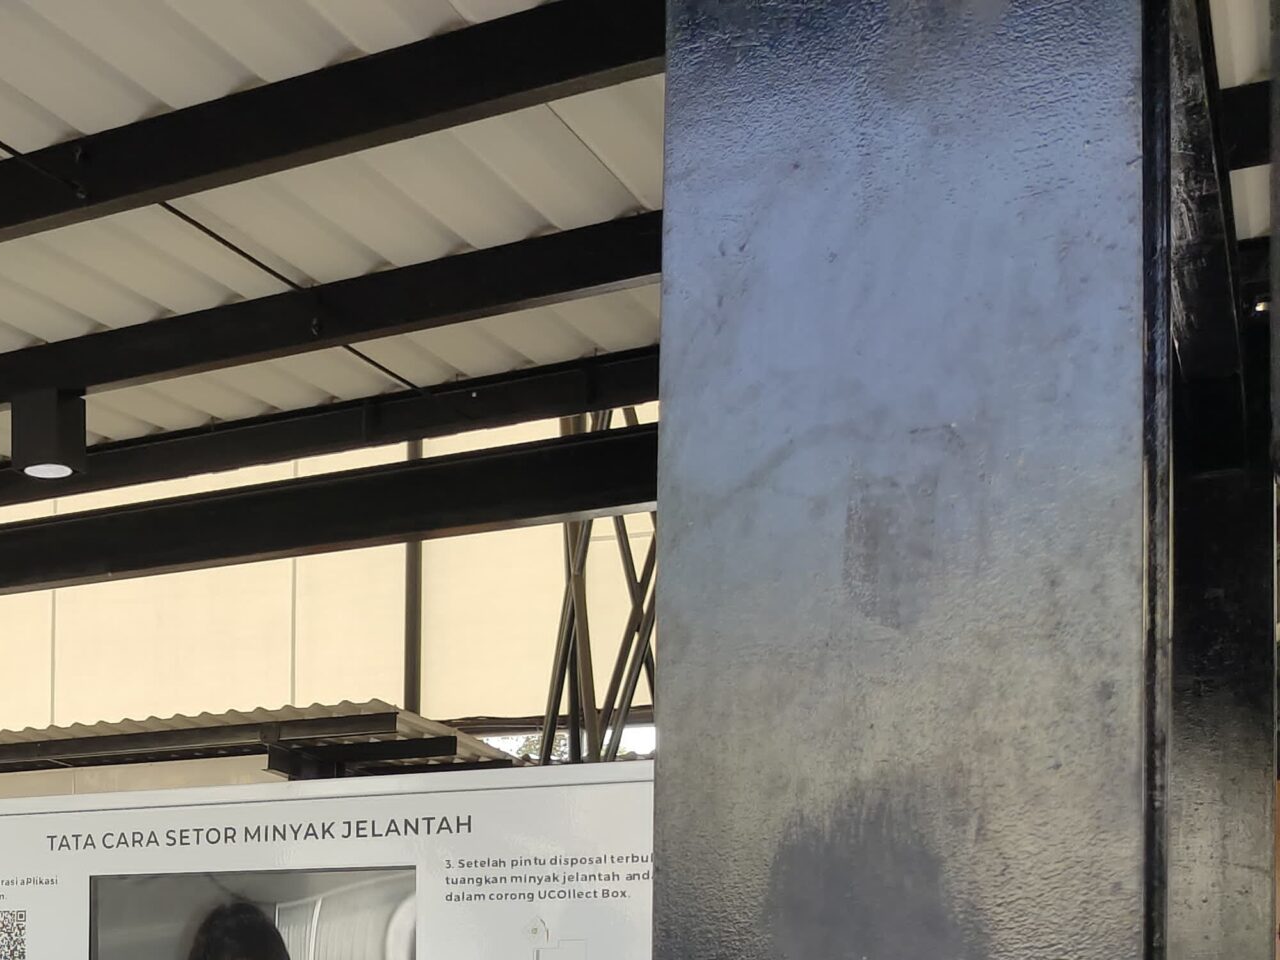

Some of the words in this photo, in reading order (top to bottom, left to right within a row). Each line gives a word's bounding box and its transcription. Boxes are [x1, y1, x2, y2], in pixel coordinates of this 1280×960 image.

[47, 834, 96, 851] TATA
[102, 831, 160, 849] CARA
[165, 826, 236, 847] SETOR
[244, 821, 336, 843] MINYAK
[341, 815, 472, 839] JELANTAH
[445, 859, 454, 869] 3.
[458, 857, 506, 868] Setelah
[511, 856, 546, 869] pintu
[549, 854, 607, 867] disposal
[445, 875, 507, 887] tuangkan
[511, 873, 559, 885] minyak
[562, 872, 620, 885] jelantah
[625, 870, 653, 881] and
[445, 892, 486, 902] dalam
[489, 892, 534, 903] corong
[601, 888, 631, 899] Box.
